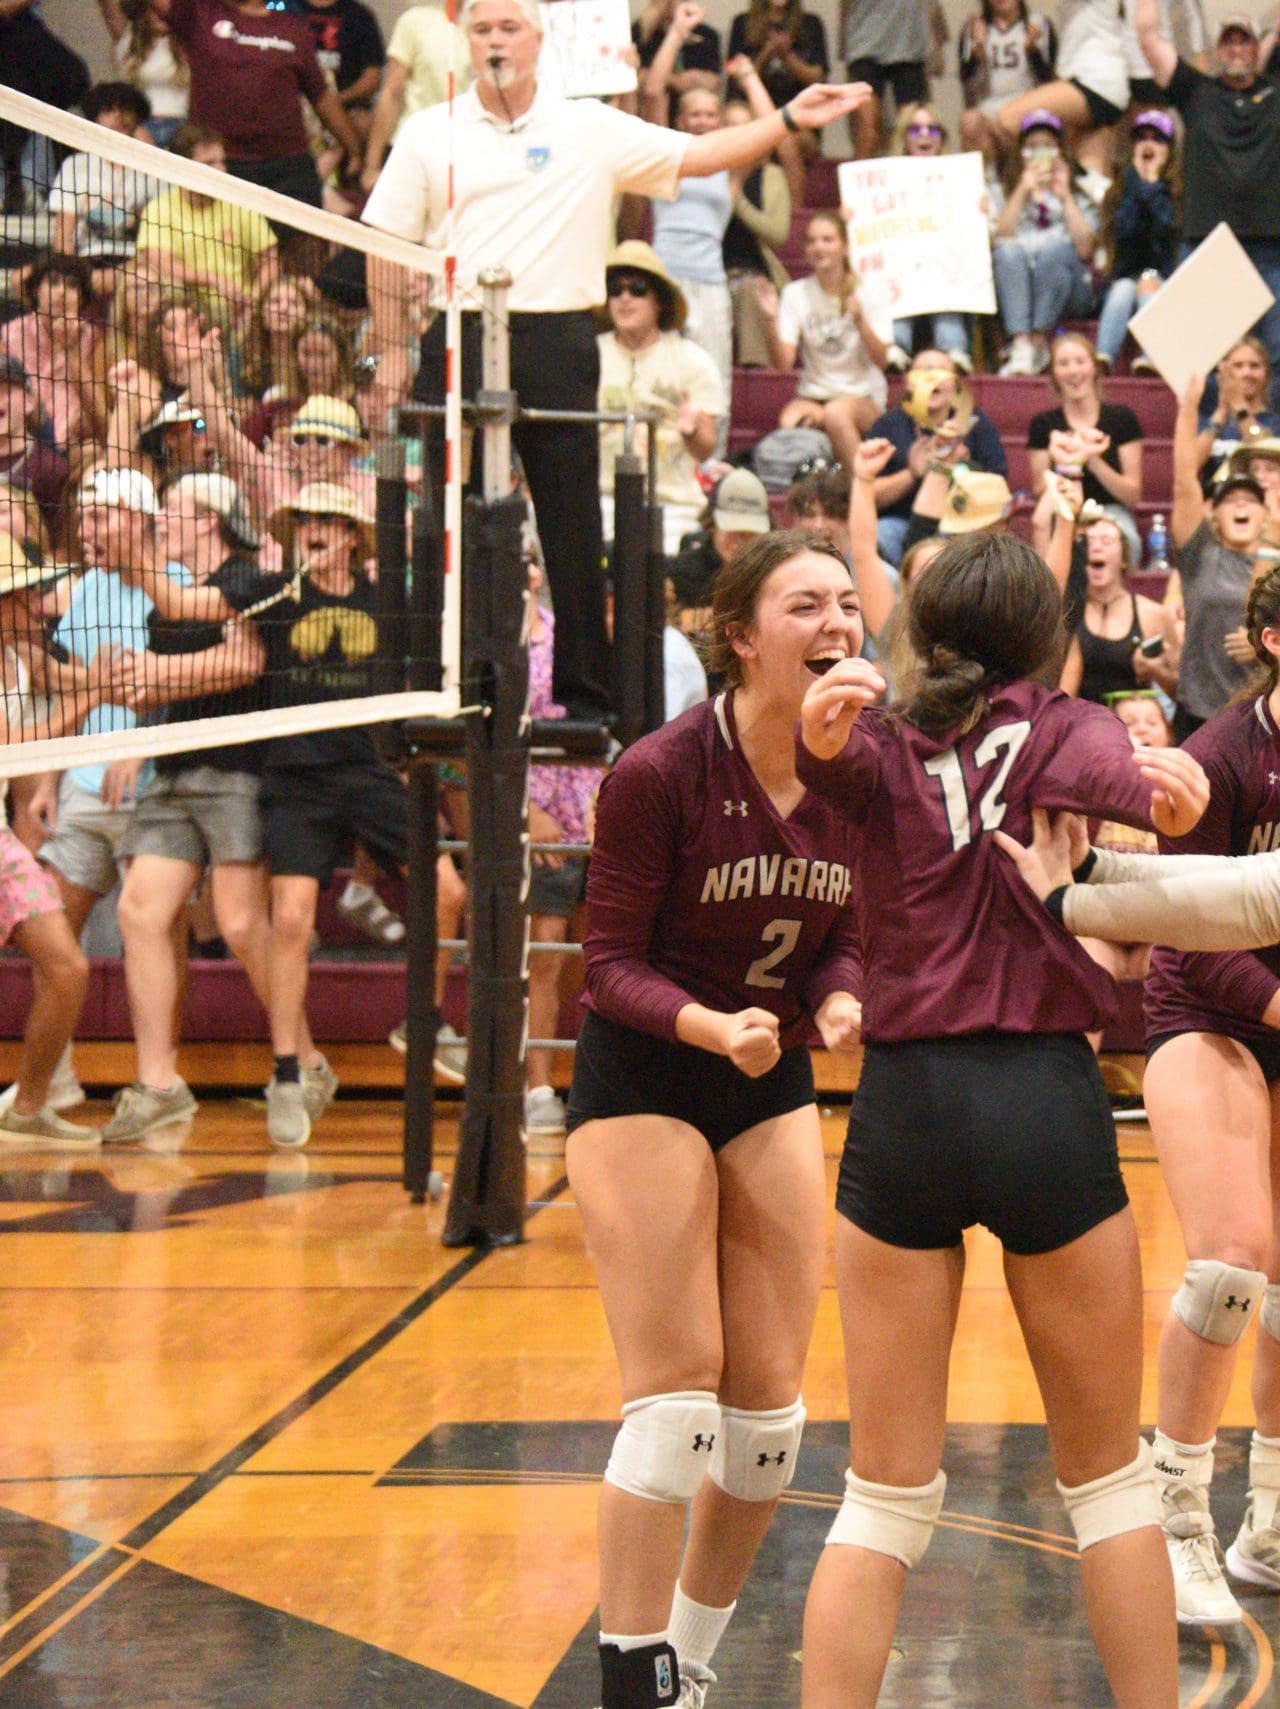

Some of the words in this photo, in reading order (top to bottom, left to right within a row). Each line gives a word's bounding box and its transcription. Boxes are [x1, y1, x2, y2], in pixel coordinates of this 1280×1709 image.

[991, 41, 1020, 69] 15
[924, 720, 1032, 852] 12
[744, 918, 803, 990] 2
